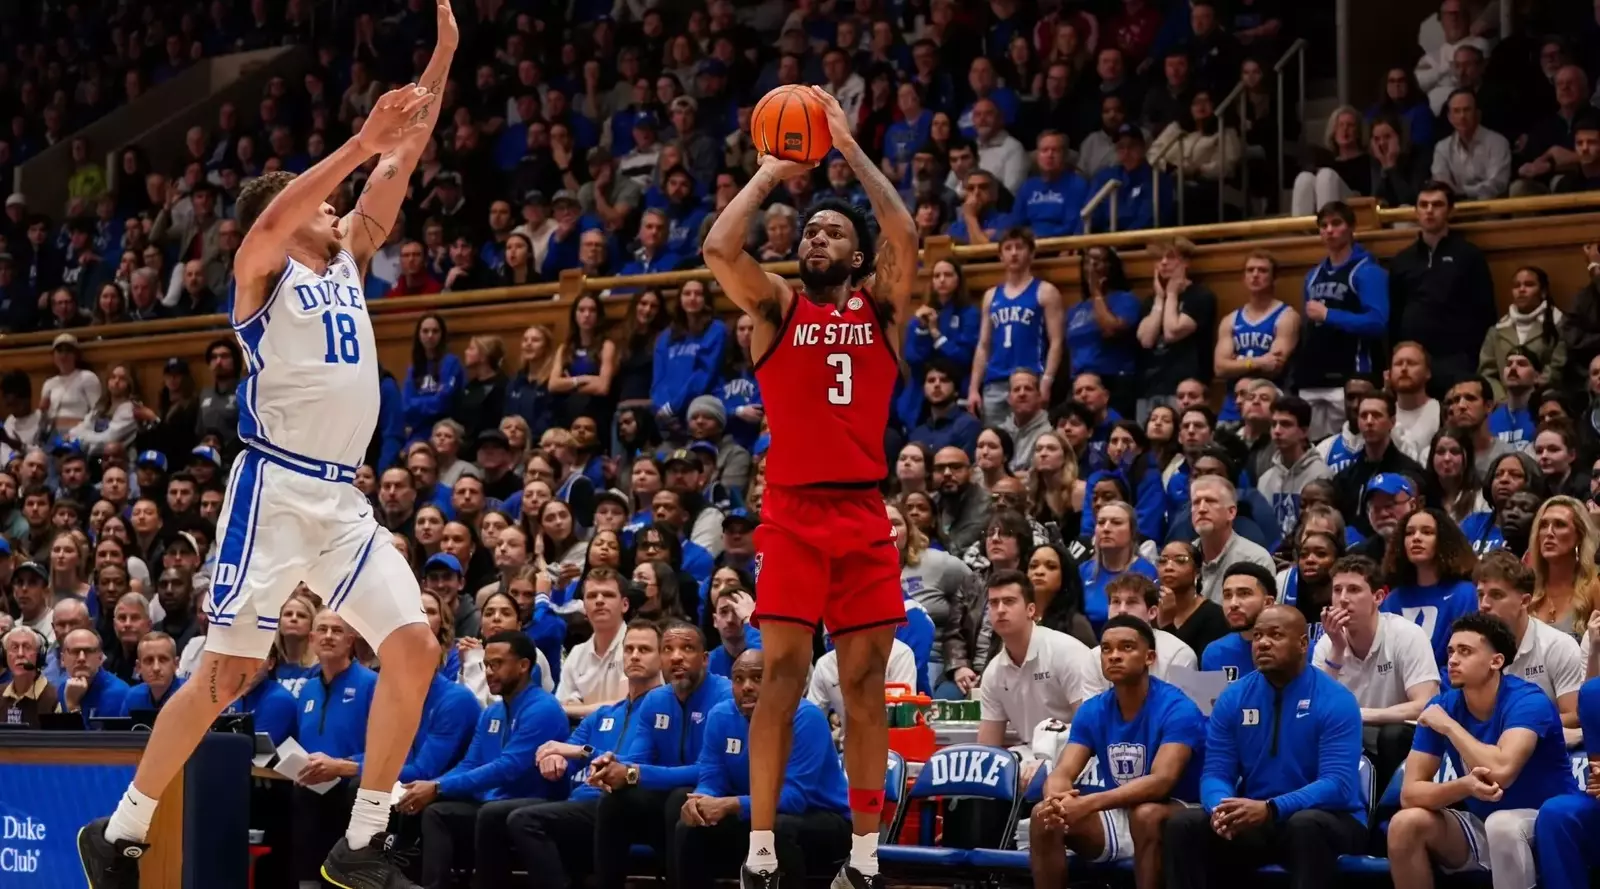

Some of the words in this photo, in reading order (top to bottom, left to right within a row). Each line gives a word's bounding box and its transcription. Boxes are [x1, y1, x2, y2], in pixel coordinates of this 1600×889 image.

[294, 280, 363, 311] DUKE
[991, 306, 1034, 329] DUKE
[322, 310, 360, 364] 18
[793, 324, 821, 347] NC
[824, 322, 874, 346] STATE
[1003, 324, 1013, 348] 1
[826, 353, 853, 405] 3
[215, 562, 237, 586] D
[930, 750, 1010, 787] DUKE
[3, 815, 46, 840] Duke
